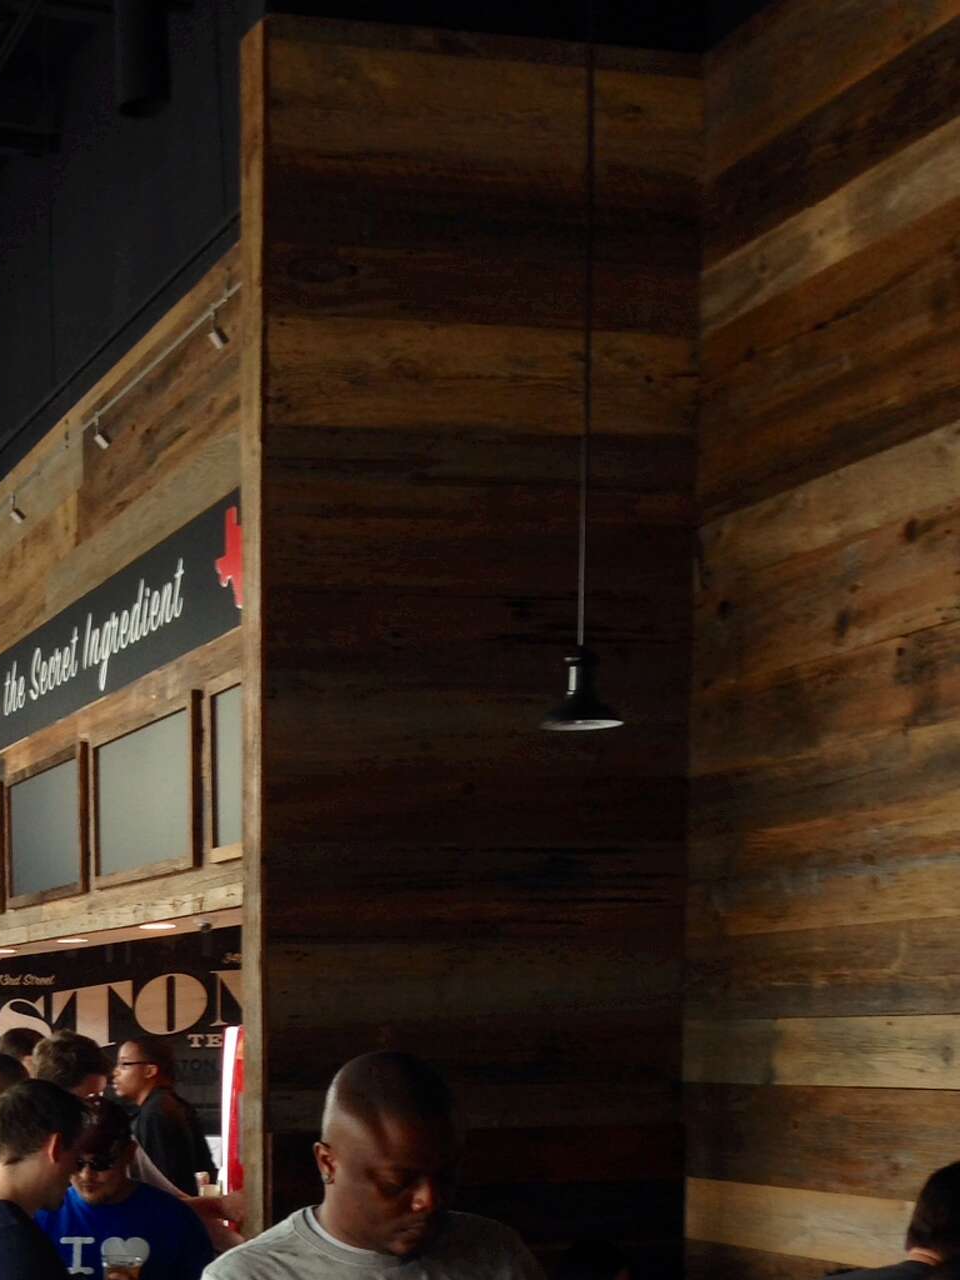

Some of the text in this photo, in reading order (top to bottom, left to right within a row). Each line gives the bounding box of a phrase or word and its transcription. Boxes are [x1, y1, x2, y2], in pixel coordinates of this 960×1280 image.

[2, 661, 27, 717] the
[28, 626, 79, 701] Secret
[82, 557, 185, 692] Ingredient
[59, 1236, 96, 1275] I
